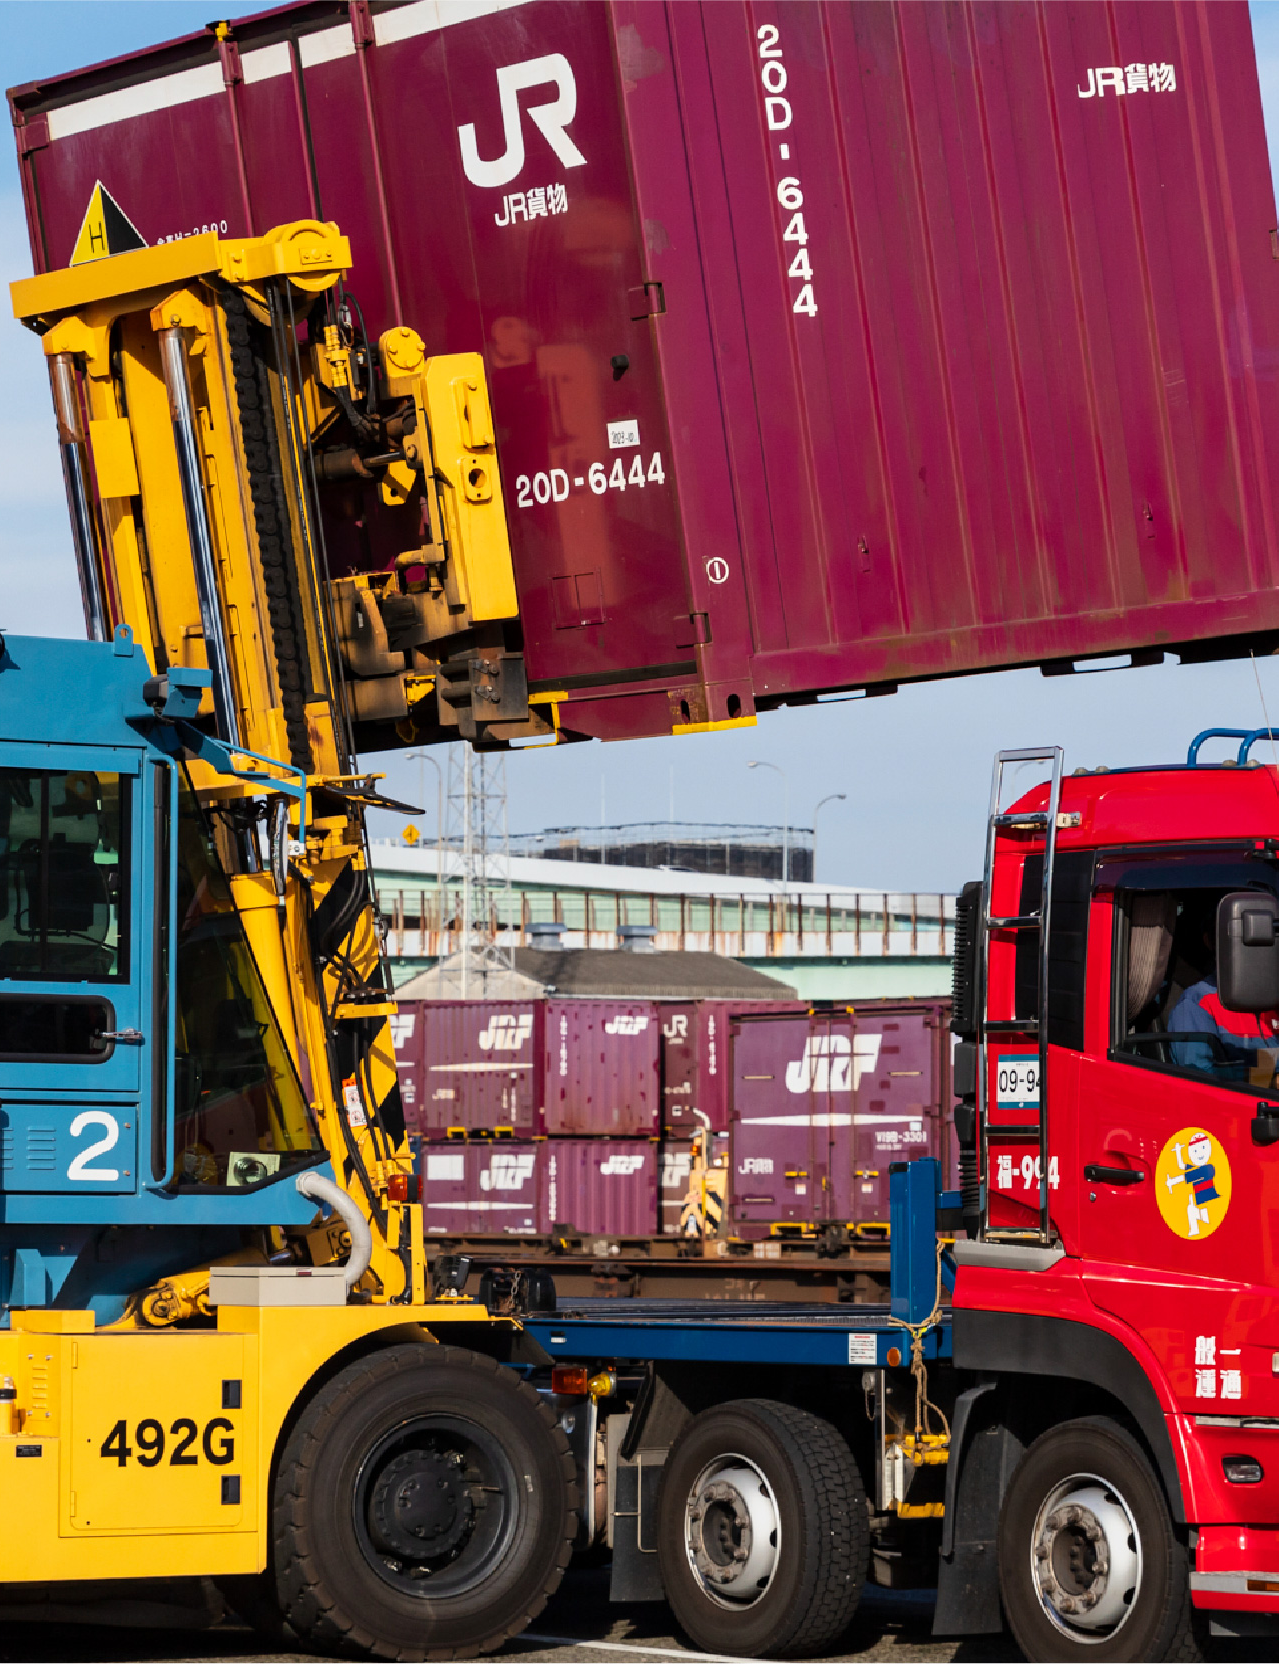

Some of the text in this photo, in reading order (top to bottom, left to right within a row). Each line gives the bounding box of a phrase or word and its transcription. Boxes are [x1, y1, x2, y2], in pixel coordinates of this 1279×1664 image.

[1077, 62, 1177, 98] JR貨物
[458, 53, 587, 187] JR
[757, 24, 818, 318] 20D-6444
[495, 183, 568, 226] JR貨物
[89, 221, 105, 253] H
[516, 452, 665, 508] 20D-6444
[479, 1014, 533, 1050] JRF
[664, 1014, 688, 1037] JR
[785, 1033, 883, 1093] JRF
[67, 1111, 119, 1180] 2
[480, 1154, 535, 1191] JRF
[100, 1418, 236, 1468] 492G
